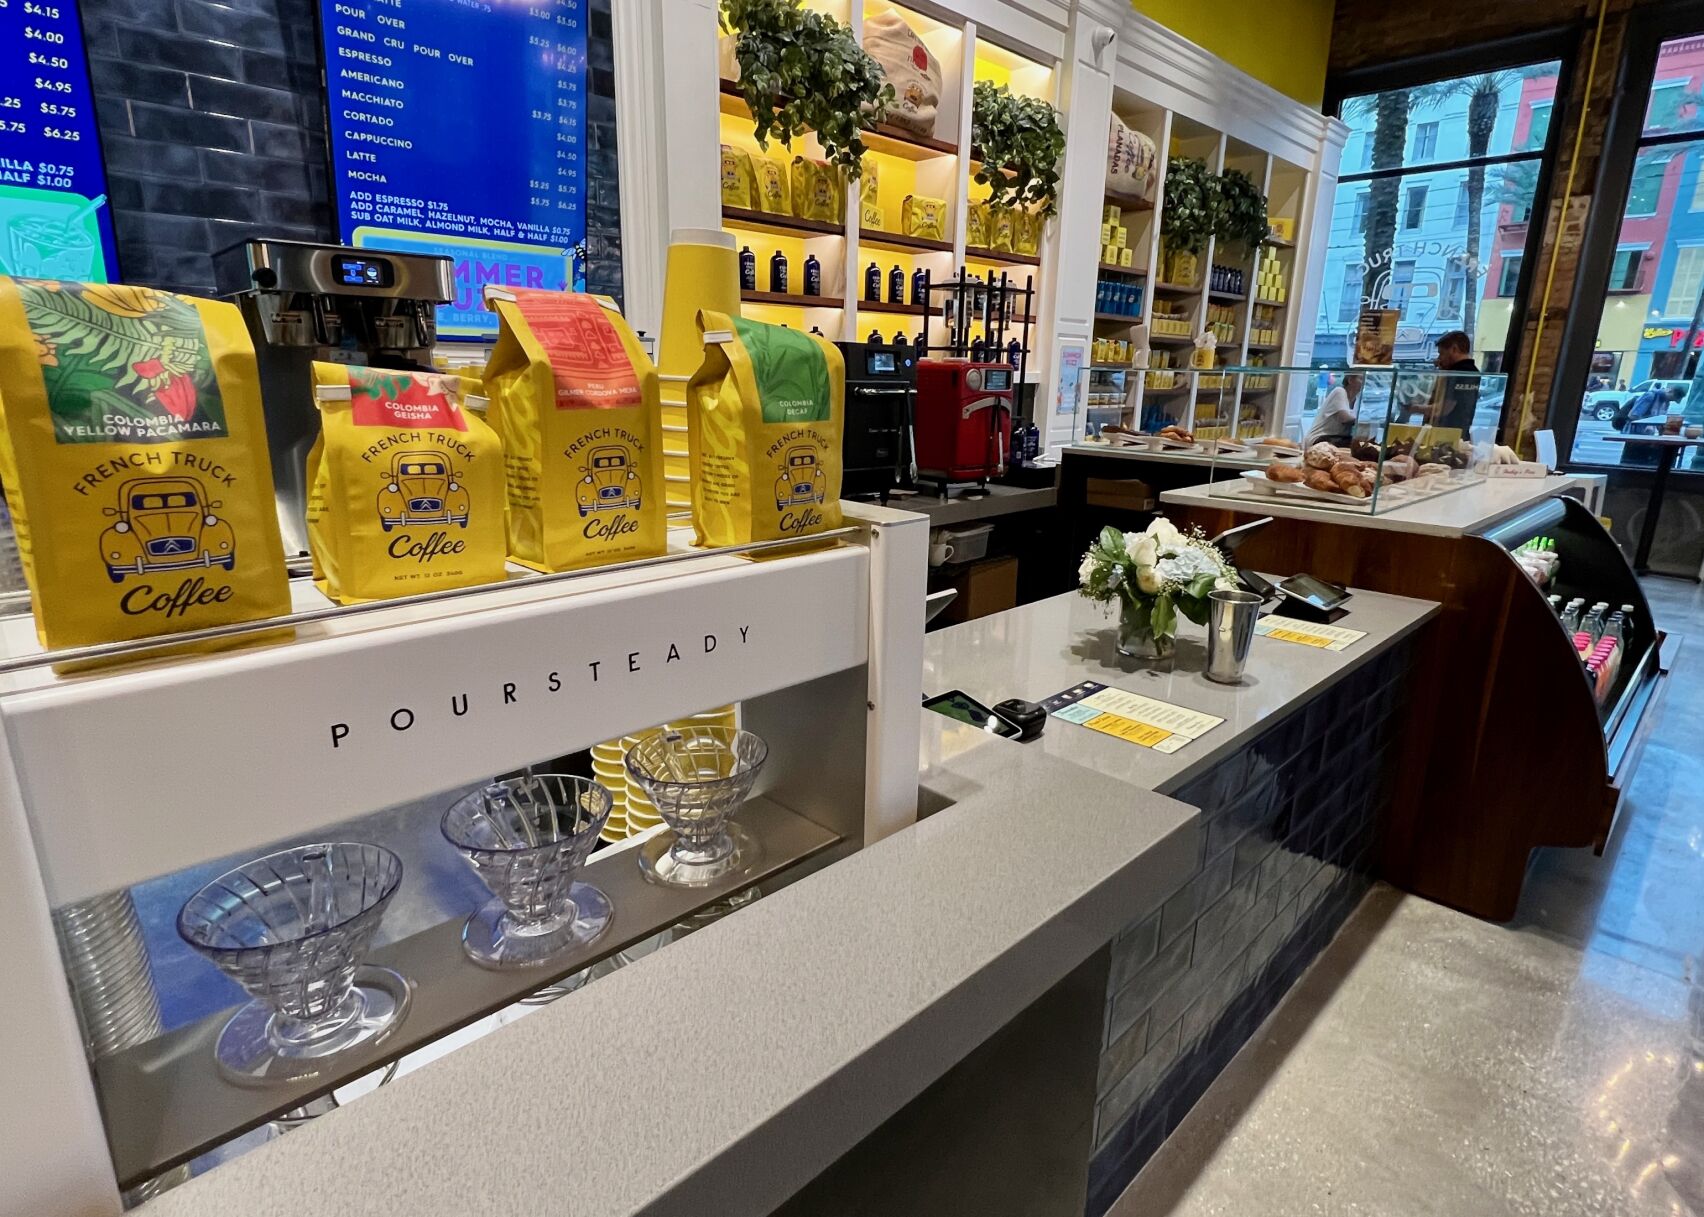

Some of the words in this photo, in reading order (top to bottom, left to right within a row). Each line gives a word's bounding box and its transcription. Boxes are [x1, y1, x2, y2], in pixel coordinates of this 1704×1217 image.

[24, 1, 60, 19] $4.15
[335, 4, 366, 20] POUR
[376, 14, 406, 30] OVER
[24, 26, 64, 44] $4.00
[336, 26, 376, 42] GRAND
[384, 37, 405, 49] CRU
[413, 44, 441, 58] POUR
[448, 53, 474, 66] OVER
[338, 46, 392, 66] ESPRESSO
[28, 52, 68, 69] $4.50
[34, 78, 72, 93] $4.95
[340, 68, 404, 89] AMERICANO
[342, 89, 404, 109] MACCHIATO
[40, 102, 76, 118] $5.75
[343, 110, 394, 126] CORTADO
[44, 126, 80, 141] $6.25
[344, 130, 412, 150] CAPPUCCINO
[346, 150, 377, 162] LATTE
[0, 170, 31, 183] ALF
[36, 174, 72, 188] $1.00
[38, 162, 74, 176] $0.75
[348, 170, 388, 184] MOCHA
[350, 190, 372, 201] ADD
[376, 194, 424, 208] ESPRESSO
[427, 200, 449, 211] $1.75
[350, 200, 373, 211] ADD
[428, 210, 478, 224] HAZELNUT,
[517, 222, 550, 233] VANILLA
[552, 226, 571, 236] $0.75
[351, 211, 371, 221] SUB
[374, 213, 394, 224] OAT
[425, 220, 465, 232] ALMOND
[494, 228, 516, 238] HALF
[518, 231, 525, 239] &
[527, 232, 548, 241] HALF
[550, 234, 569, 244] $1.00
[384, 401, 440, 412] COLOMBIA
[778, 399, 814, 408] COLOMBIA
[786, 408, 808, 416] DECAF
[102, 414, 185, 428] COLOMBIA
[394, 411, 433, 420] GEISHA
[64, 425, 132, 437] YELLOW
[136, 420, 222, 438] PACAMARA
[361, 432, 422, 463] FRENCH
[427, 432, 476, 462] TRUCK
[564, 428, 610, 460] FRENCH
[614, 428, 646, 454] TRUCK
[766, 429, 804, 460] FRENCH
[807, 430, 830, 450] TRUCK
[73, 451, 162, 496] FRENCH
[171, 450, 238, 489] TRUCK
[582, 514, 640, 542] Coffee
[779, 508, 823, 533] Coffee
[388, 531, 466, 563] Coffee
[120, 576, 236, 618] Coffee
[330, 625, 750, 749] POURSTEADY
